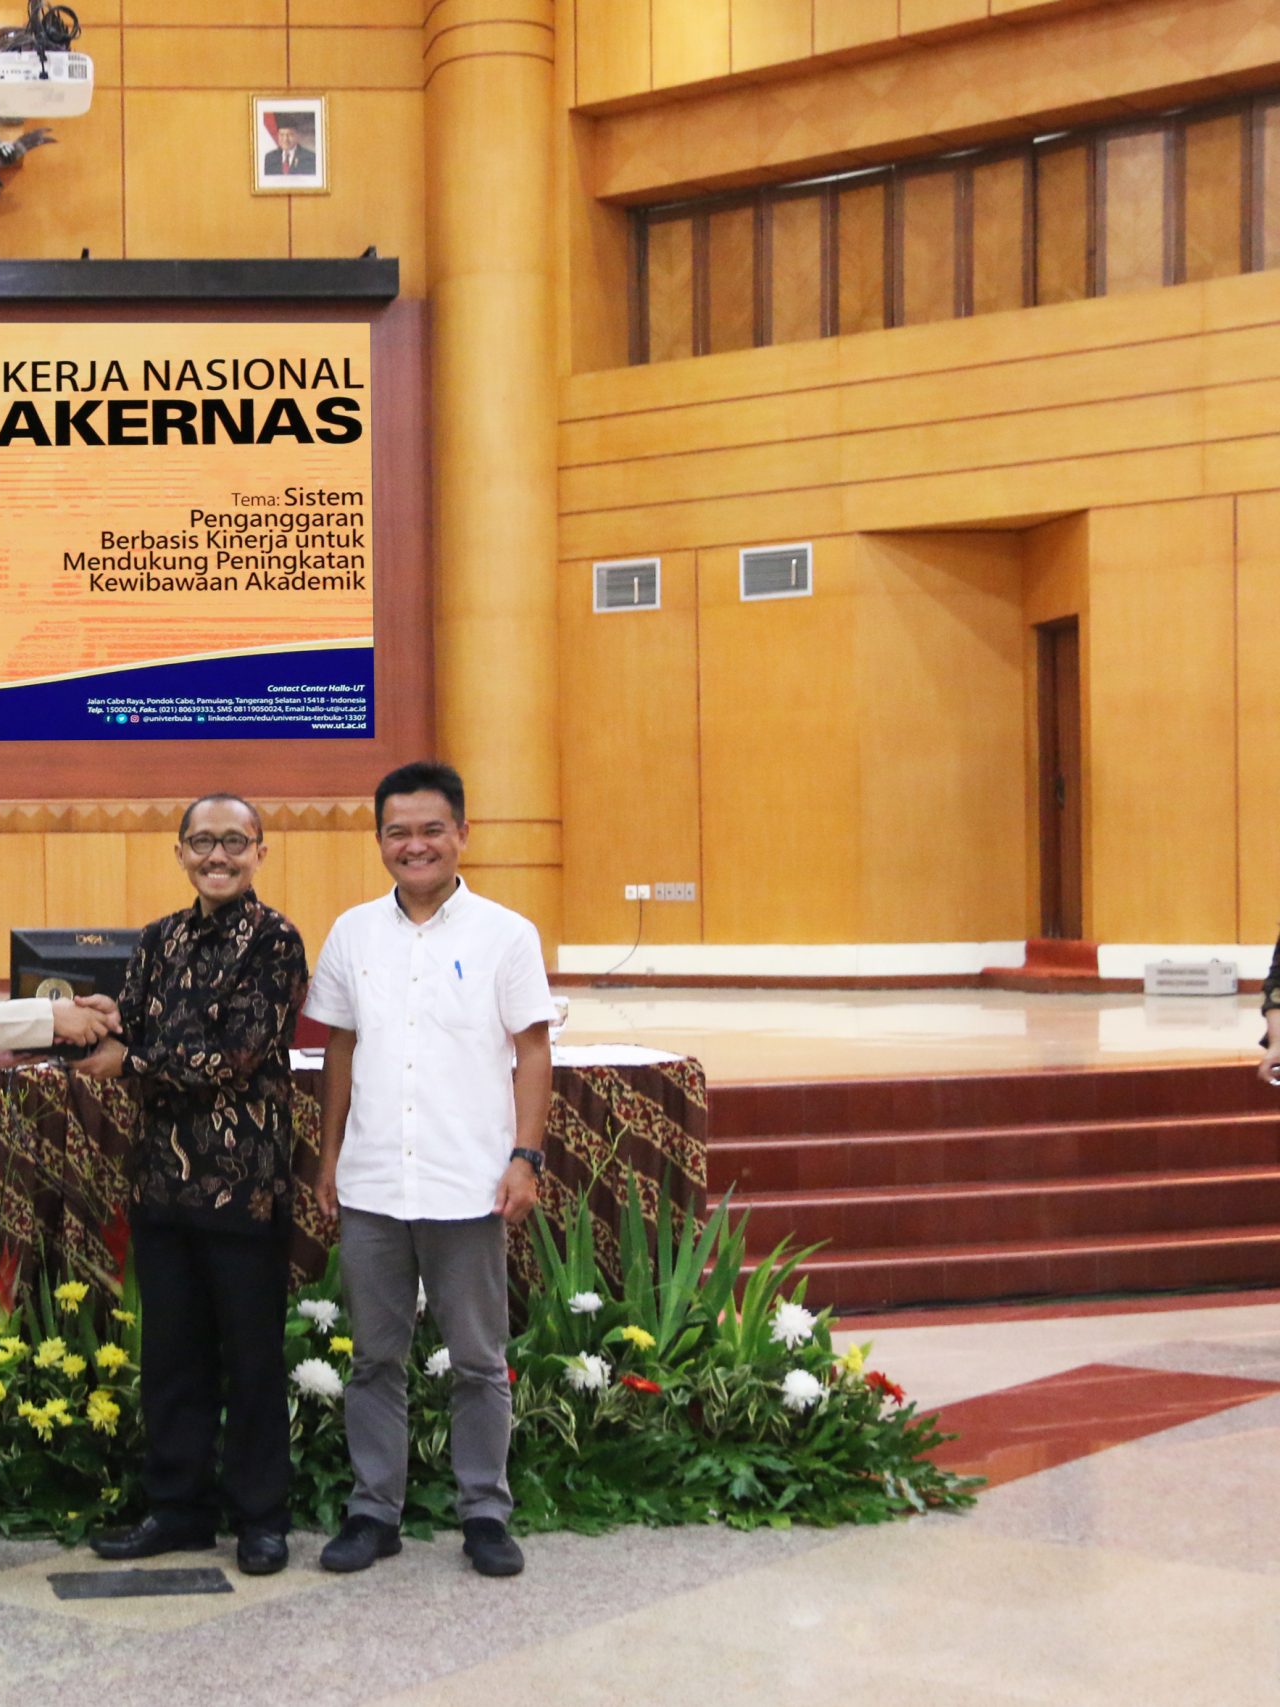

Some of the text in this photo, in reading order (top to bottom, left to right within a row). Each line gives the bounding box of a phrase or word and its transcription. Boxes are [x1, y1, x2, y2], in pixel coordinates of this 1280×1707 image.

[3, 360, 130, 393] KERJA
[144, 357, 365, 391] NASIONAL
[231, 487, 364, 507] Tema: Sistem
[190, 509, 364, 533] Penganggaran
[101, 529, 366, 553] Berbasis Kinerja untuk
[63, 550, 365, 575] Mendukung Peningkatan
[89, 570, 366, 592] Kewibawaan Akademik
[328, 684, 366, 692] Hallo-UT
[87, 706, 105, 714] Telp.
[106, 706, 138, 714] 1500024,
[233, 705, 284, 713] 08119050024,
[306, 705, 367, 713] hallo-ut@ut.ac.id
[126, 698, 146, 706] Raya,
[146, 697, 174, 705] Pondok
[175, 697, 195, 705] Cabe,
[196, 697, 235, 706] Pamulang,
[235, 697, 274, 706] Tangerang
[142, 715, 193, 723] @univterbuka
